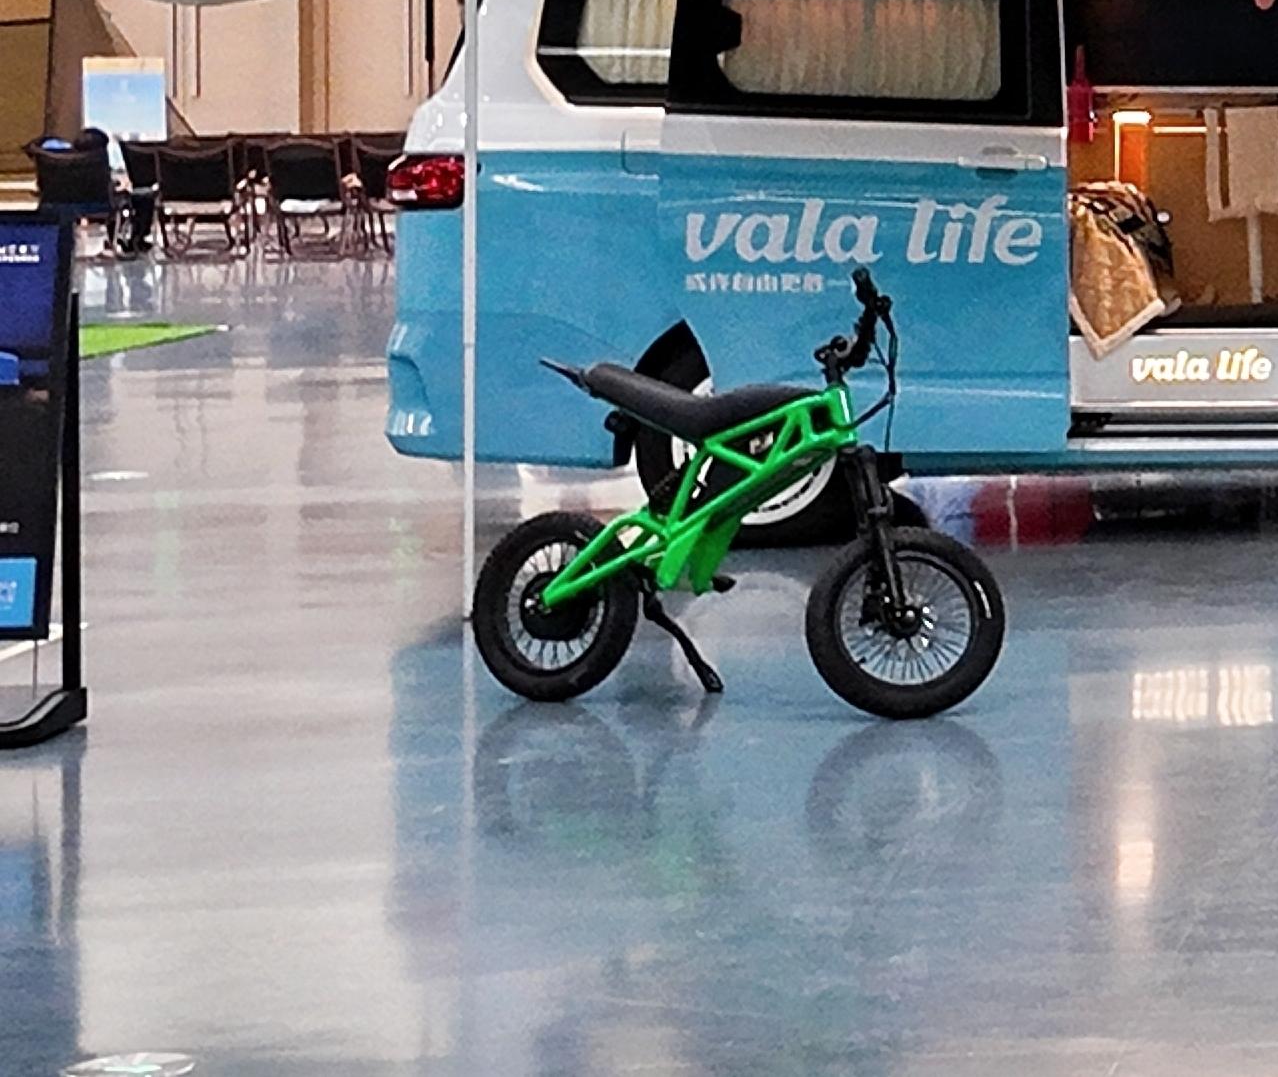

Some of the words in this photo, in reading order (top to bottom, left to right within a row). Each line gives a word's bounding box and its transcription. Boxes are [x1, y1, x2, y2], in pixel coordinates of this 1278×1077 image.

[684, 198, 884, 264] vala
[906, 194, 1043, 265] life
[1131, 349, 1210, 383] vala
[1215, 346, 1273, 382] life
